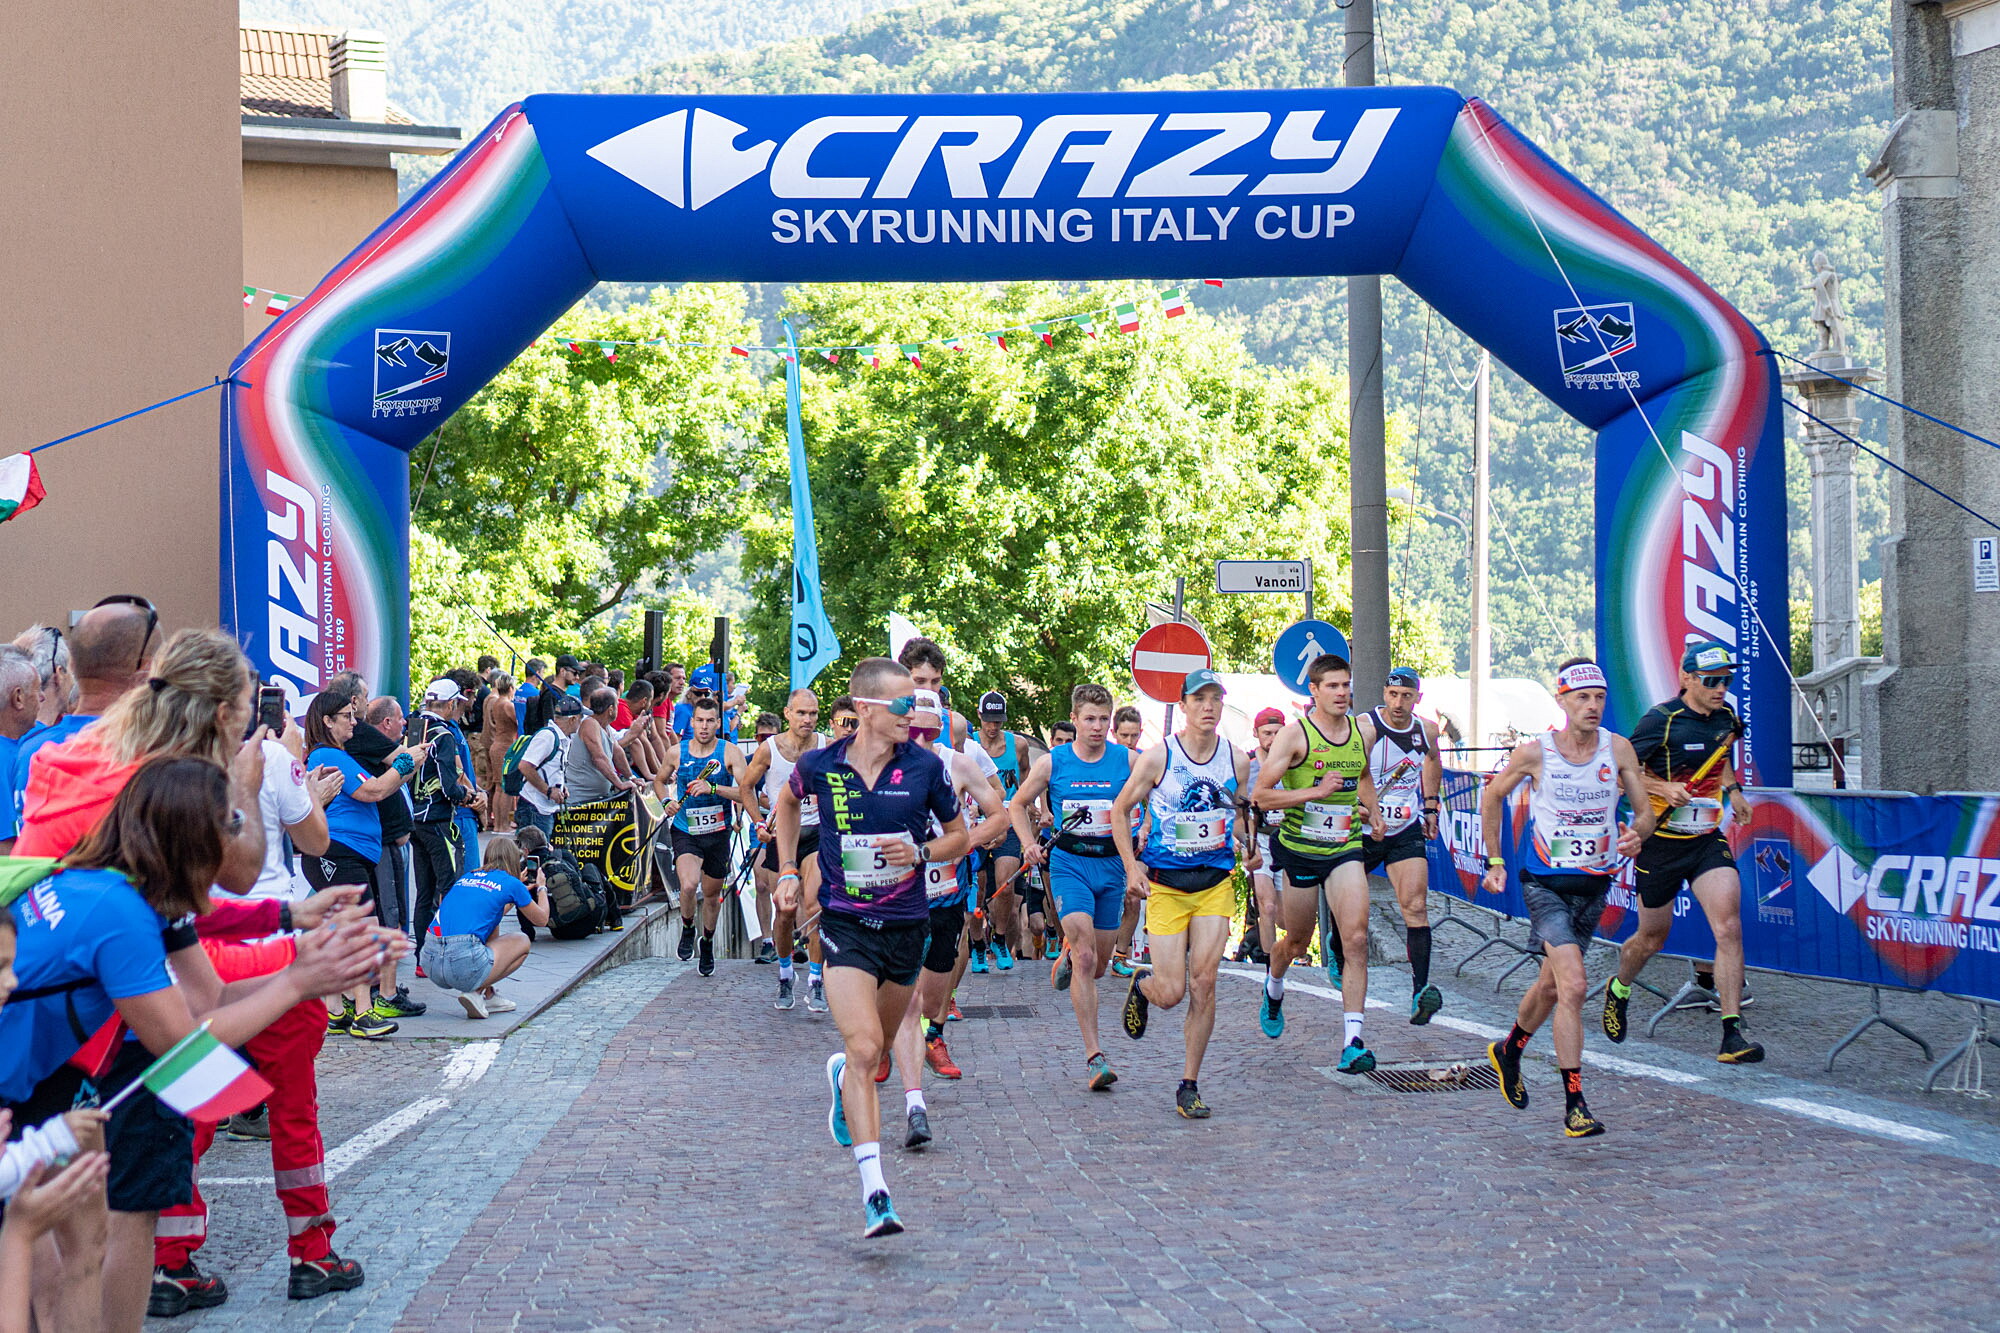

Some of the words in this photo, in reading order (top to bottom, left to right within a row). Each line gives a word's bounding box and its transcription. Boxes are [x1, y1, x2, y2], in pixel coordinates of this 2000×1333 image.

[769, 108, 1402, 200] CRAZY
[771, 208, 1094, 244] SKYRUNNING
[1110, 206, 1240, 243] ITALY
[1254, 203, 1356, 240] CUP
[1564, 371, 1640, 382] SKYRUNNING
[1565, 379, 1641, 390] ITALIA
[372, 404, 440, 418] ITALIA
[374, 397, 442, 409] SKYRUNNING
[1737, 446, 1747, 518] CLOTHING
[321, 484, 331, 557] CLOTHING
[1739, 522, 1749, 599] MOUNTAIN
[1255, 576, 1300, 588] Vanoni
[323, 561, 333, 637] MOUNTAIN
[1741, 602, 1750, 641] LIGHT
[336, 618, 345, 650] 1989
[1751, 616, 1760, 658] SINCE
[1742, 646, 1750, 655] &
[324, 641, 334, 680] LIGHT
[1742, 659, 1751, 691] FAST
[1326, 761, 1362, 769] MERCURIO
[610, 801, 629, 809] VARI
[825, 772, 852, 834] ARIO
[590, 813, 626, 821] BOLLATI
[695, 814, 717, 826] 155
[1323, 816, 1333, 829] 4
[1692, 808, 1699, 821] 1
[595, 825, 607, 833] TV
[1199, 824, 1209, 838] 3
[855, 839, 868, 848] K2
[1570, 840, 1596, 857] 33
[873, 852, 888, 870] 5
[1867, 854, 2000, 921] CRAZ
[1673, 896, 1691, 917] UP
[1866, 915, 1968, 949] SKYRUNNING
